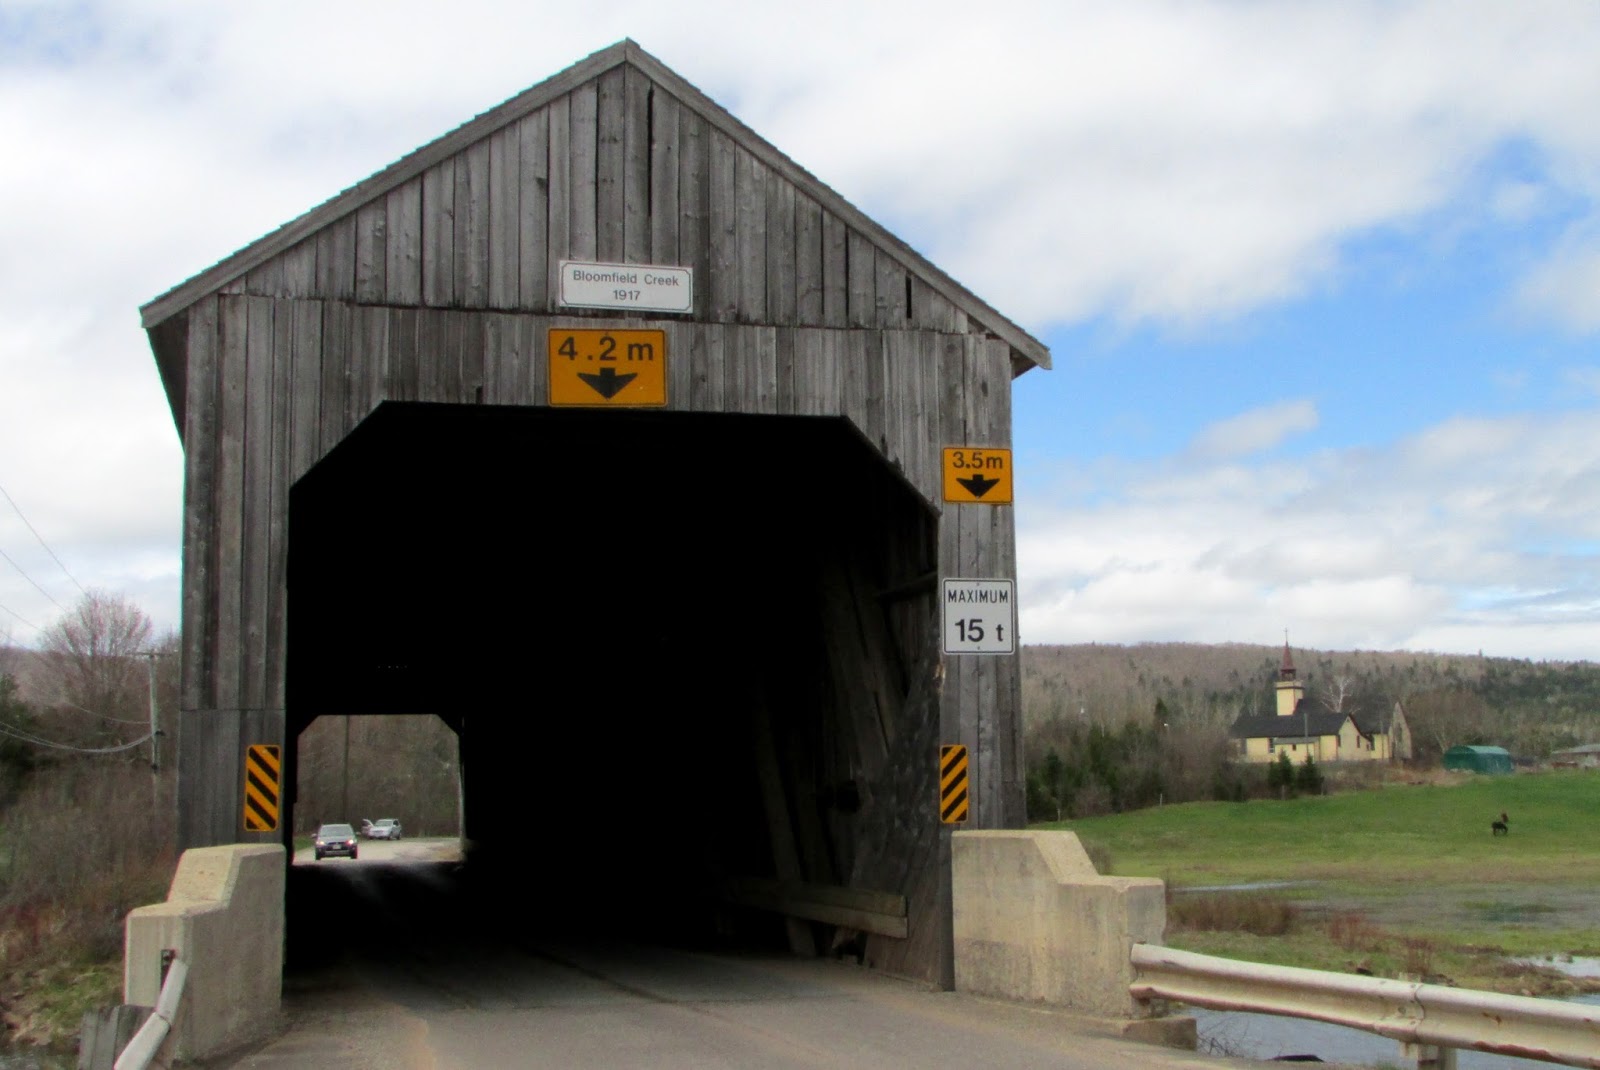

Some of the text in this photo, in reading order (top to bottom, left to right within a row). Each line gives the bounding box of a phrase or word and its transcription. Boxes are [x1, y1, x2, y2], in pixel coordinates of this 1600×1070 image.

[573, 269, 679, 287] Bloomfield Creek
[613, 289, 641, 301] 1917
[948, 589, 1008, 603] MAXIMUM
[955, 618, 1004, 642] 15 t
